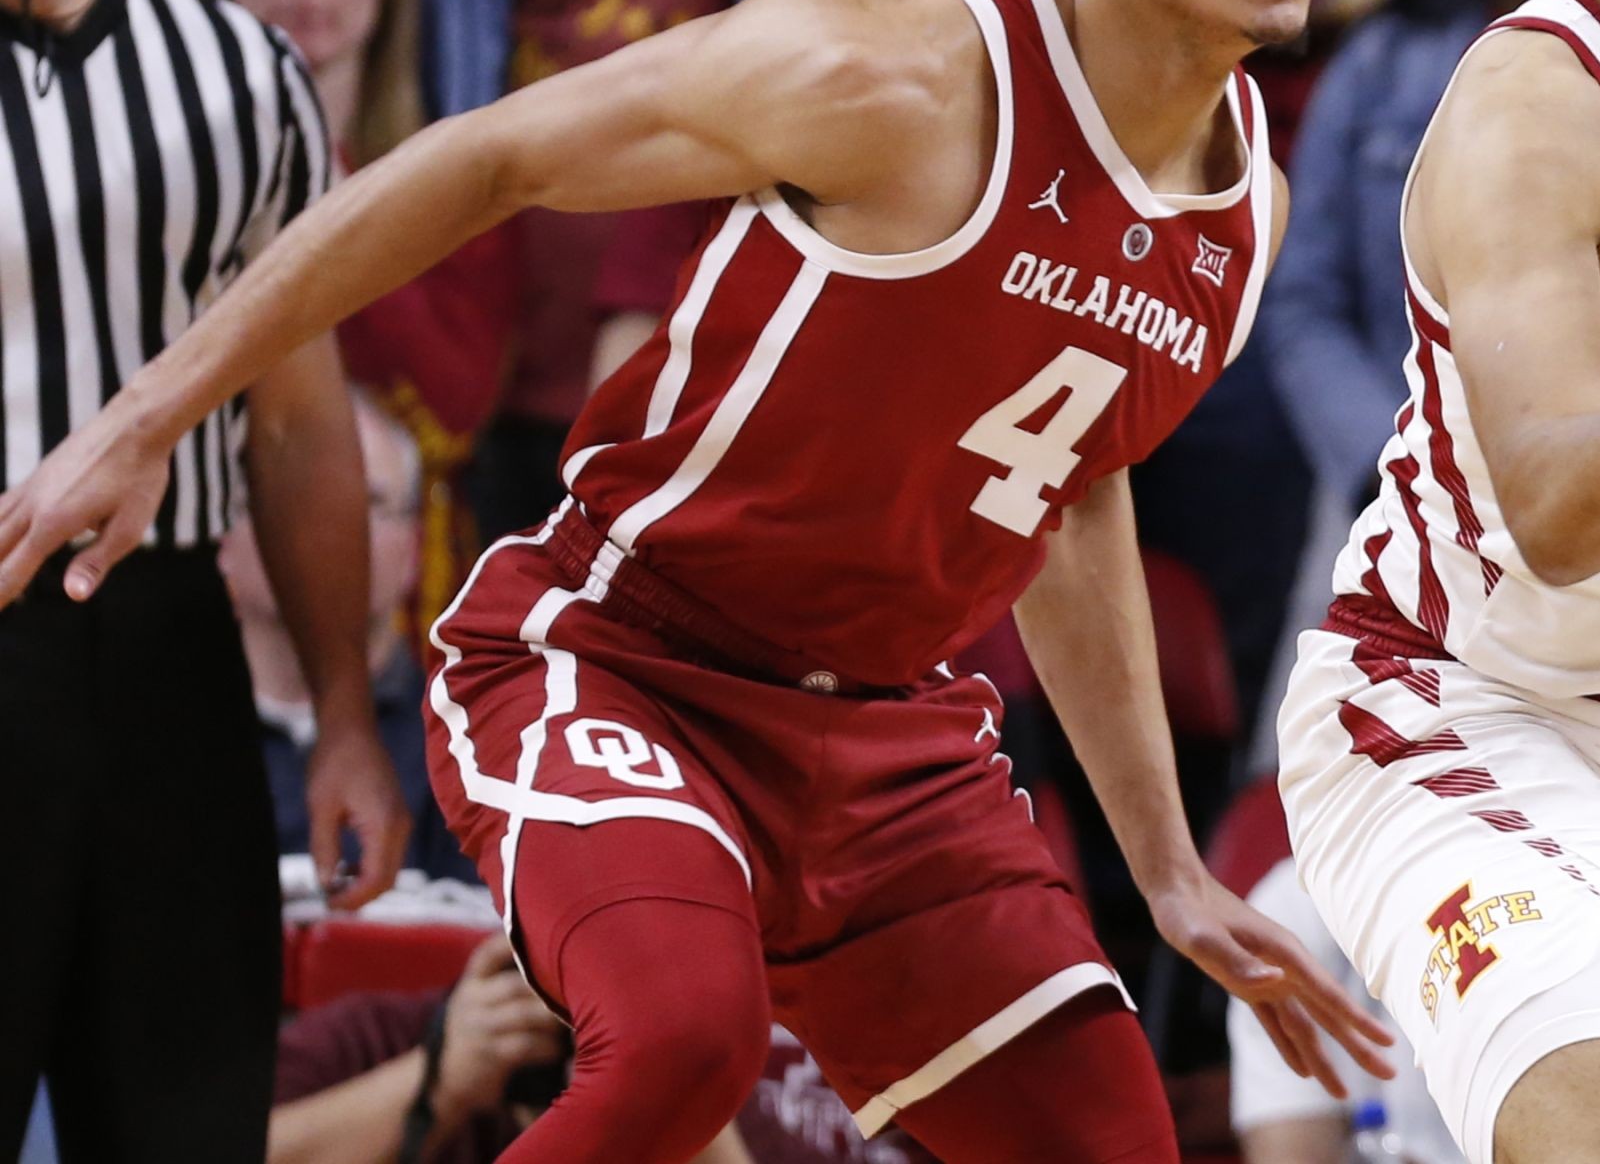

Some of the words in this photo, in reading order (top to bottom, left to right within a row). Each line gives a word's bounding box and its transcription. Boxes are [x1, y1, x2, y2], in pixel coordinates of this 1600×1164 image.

[1001, 251, 1208, 373] OKLAHOMA
[957, 345, 1128, 538] 4
[1419, 890, 1543, 1025] STATE
